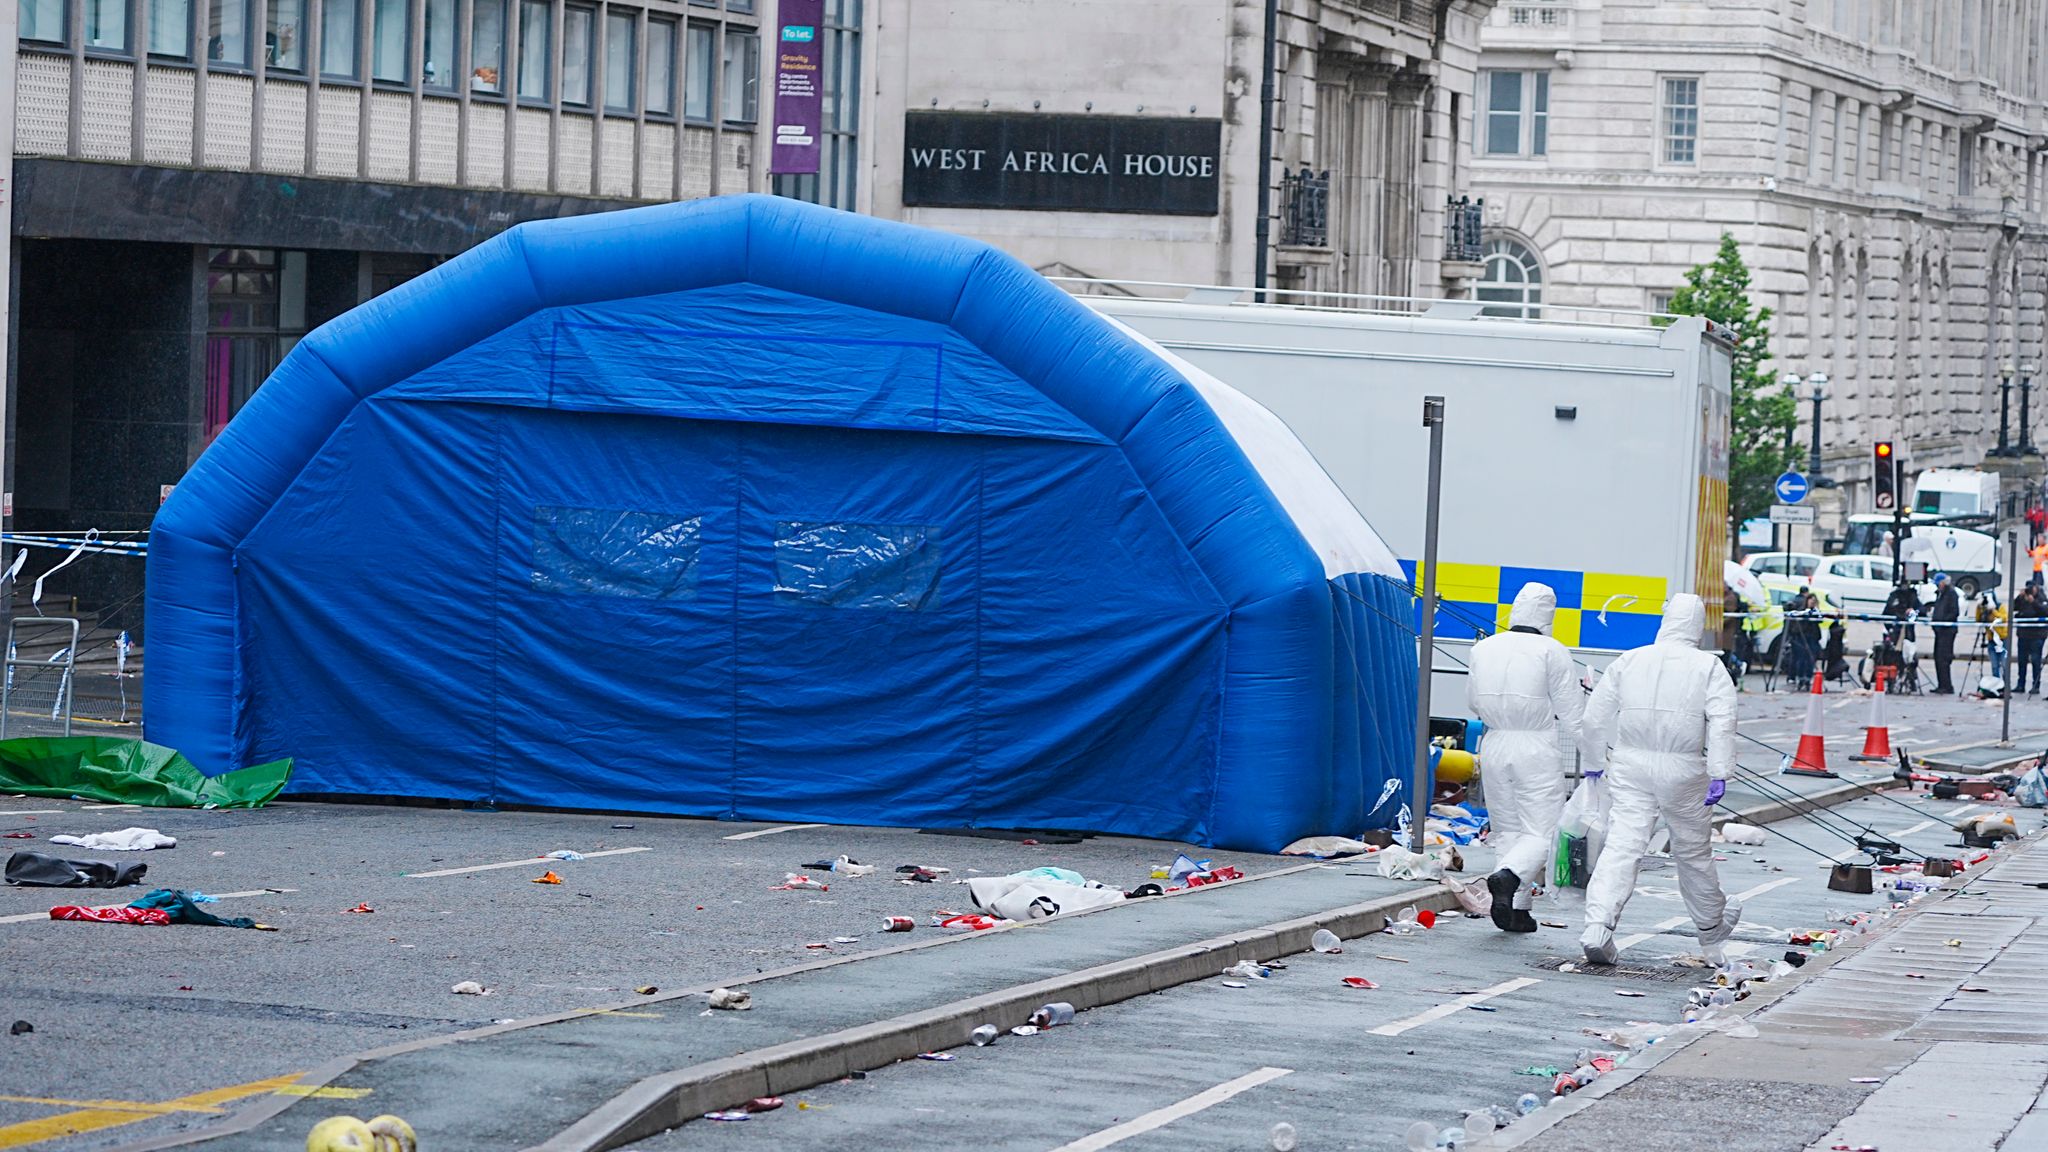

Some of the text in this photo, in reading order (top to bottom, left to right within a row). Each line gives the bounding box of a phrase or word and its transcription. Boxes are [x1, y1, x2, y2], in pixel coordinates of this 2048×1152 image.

[784, 29, 795, 38] To
[781, 55, 808, 64] Gravity
[781, 63, 816, 71] Residence
[911, 147, 1213, 178] WEST AFRICA HOUSE
